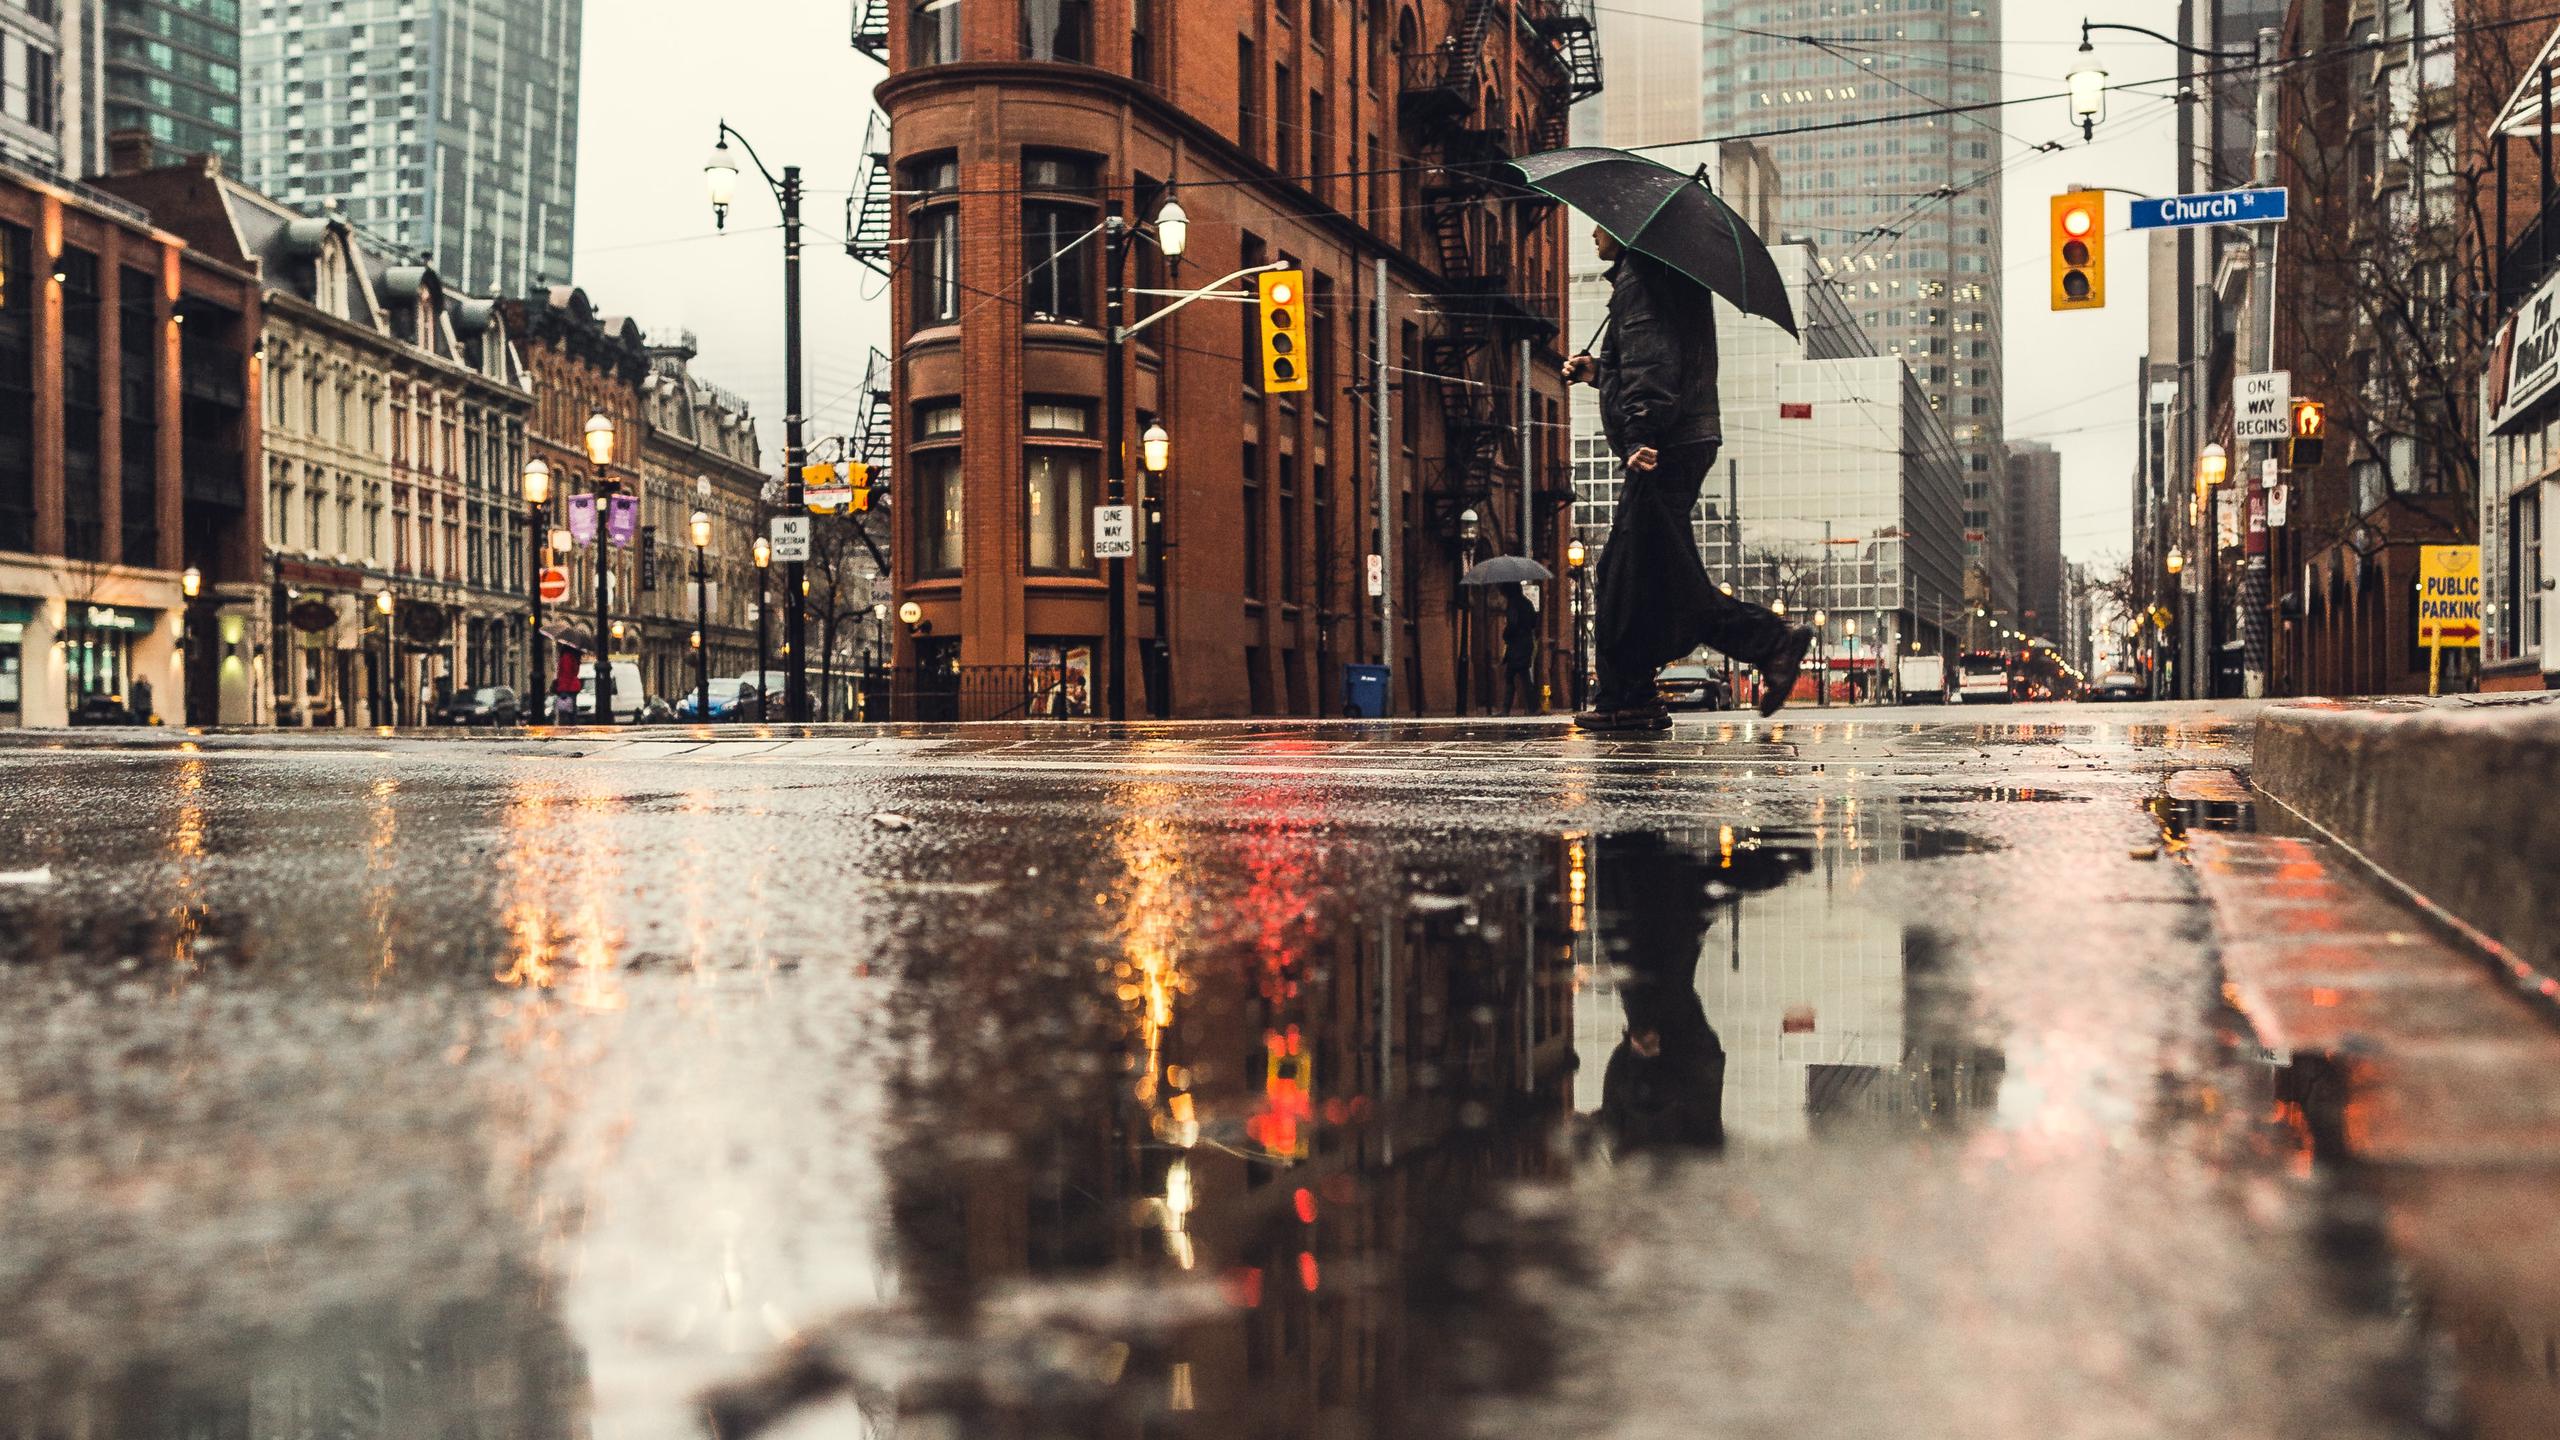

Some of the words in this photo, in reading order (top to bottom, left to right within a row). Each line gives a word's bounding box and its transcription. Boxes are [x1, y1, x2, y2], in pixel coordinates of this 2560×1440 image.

[2160, 195, 2237, 221] Church
[2247, 379, 2275, 394] ONE
[2248, 399, 2275, 415] WAY
[2236, 417, 2287, 435] BEGINS
[1103, 510, 1122, 521] ONE
[783, 521, 797, 534] NO
[1103, 526, 1122, 537] WAY
[1095, 541, 1131, 553] BEGINS
[2427, 576, 2480, 596] PUBLIC
